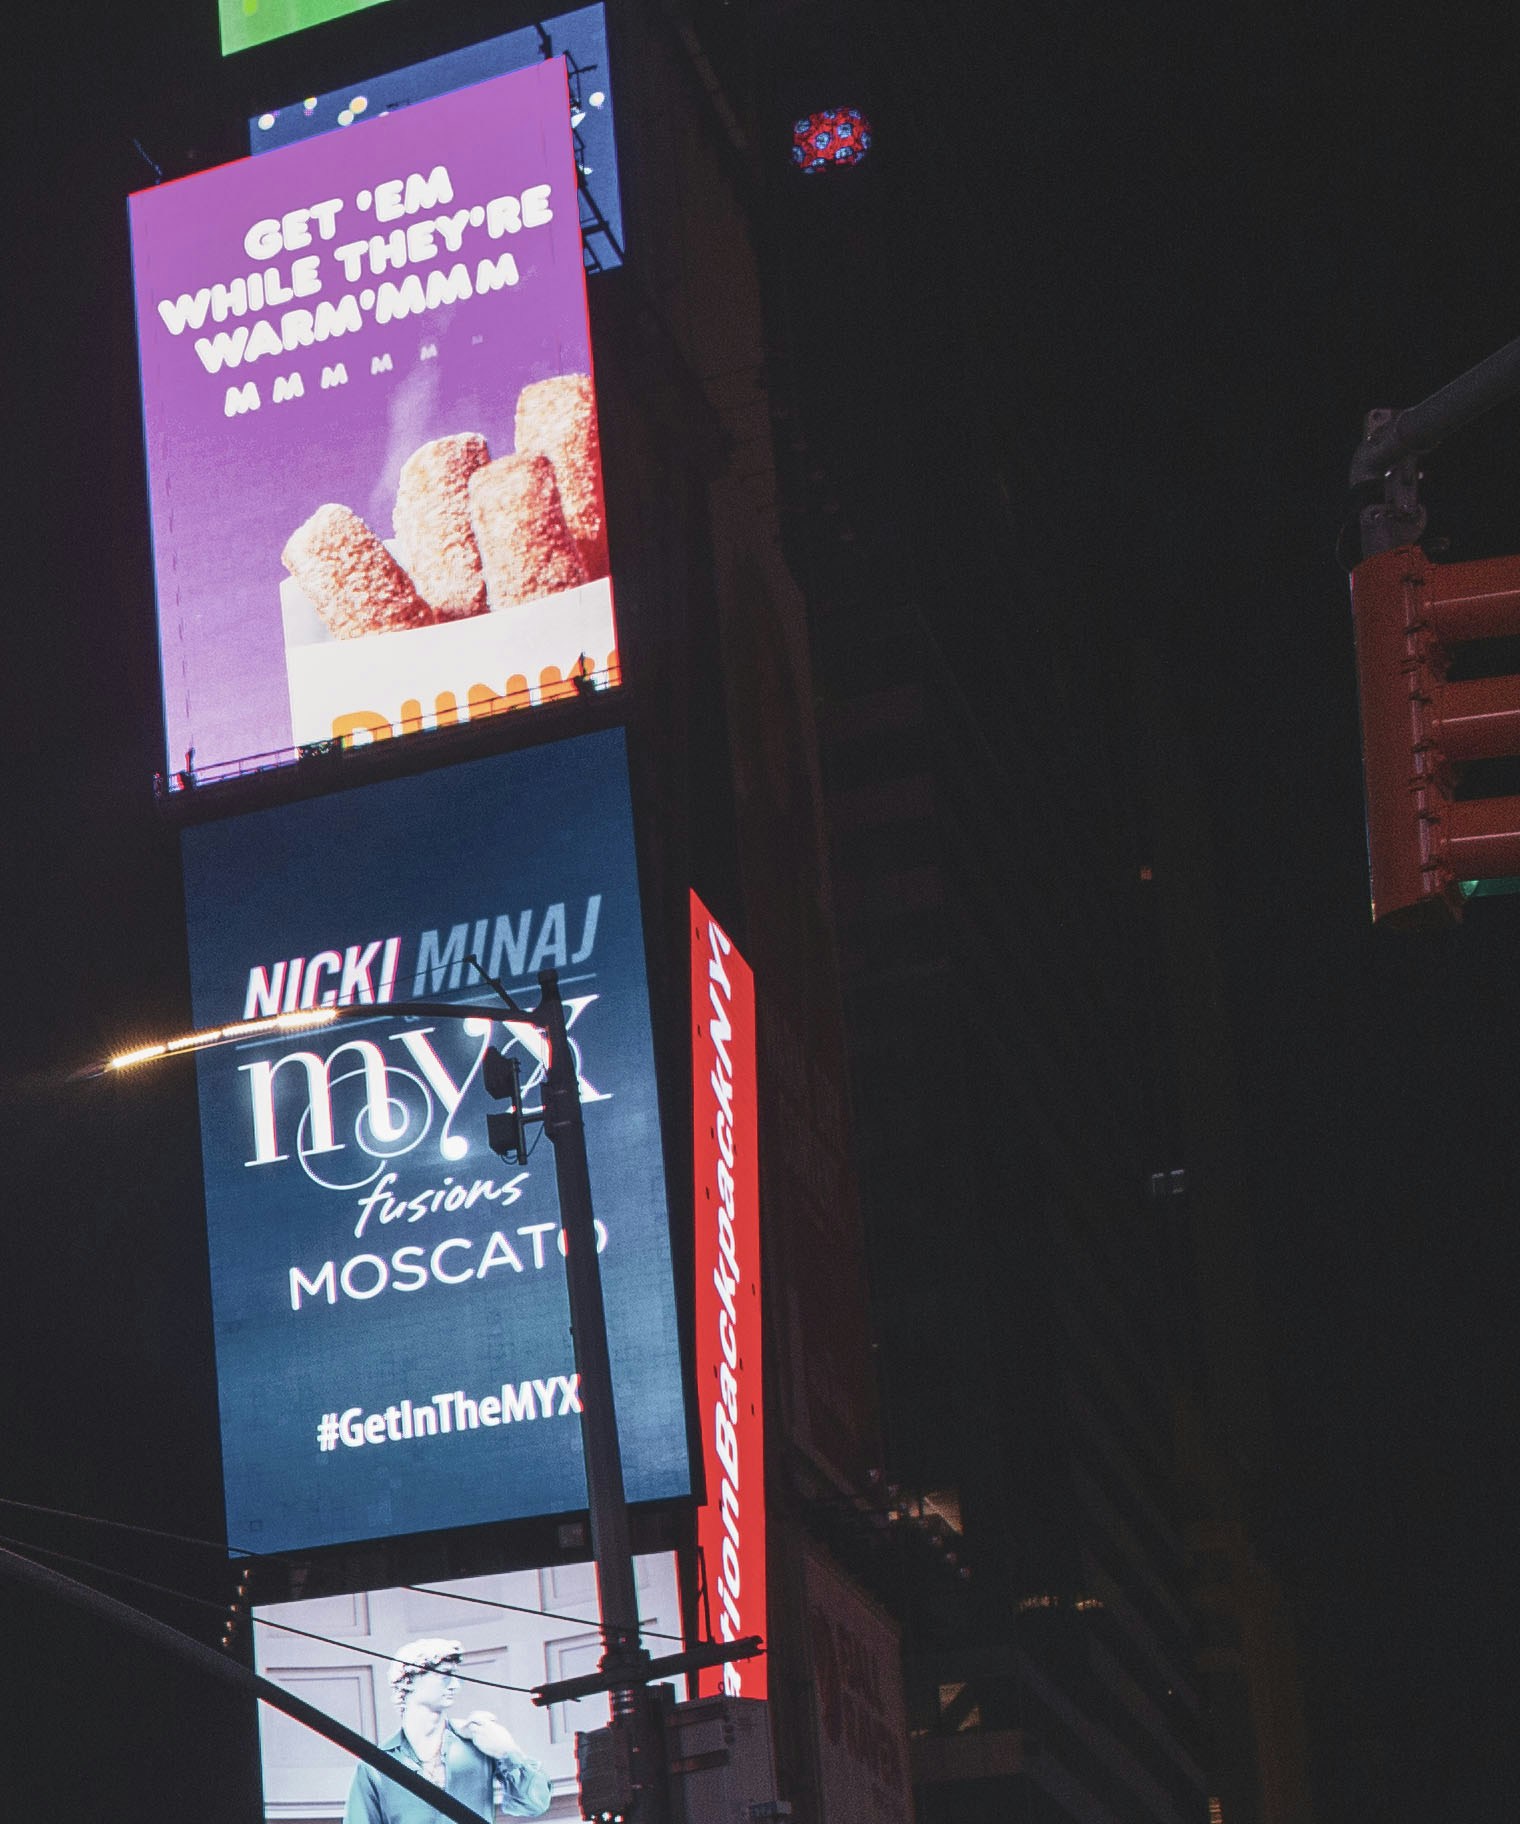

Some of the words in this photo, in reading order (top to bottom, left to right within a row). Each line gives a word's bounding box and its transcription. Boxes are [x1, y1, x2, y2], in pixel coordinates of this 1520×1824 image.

[158, 253, 322, 336] WHILE
[334, 184, 553, 284] THEY'RE
[244, 199, 345, 261] GET
[356, 165, 454, 223] 'EM
[243, 936, 402, 1021] NICKI
[412, 894, 603, 1000] MINAJ
[354, 1171, 532, 1239] fusions
[316, 1373, 584, 1453] #GetInTheMYX
